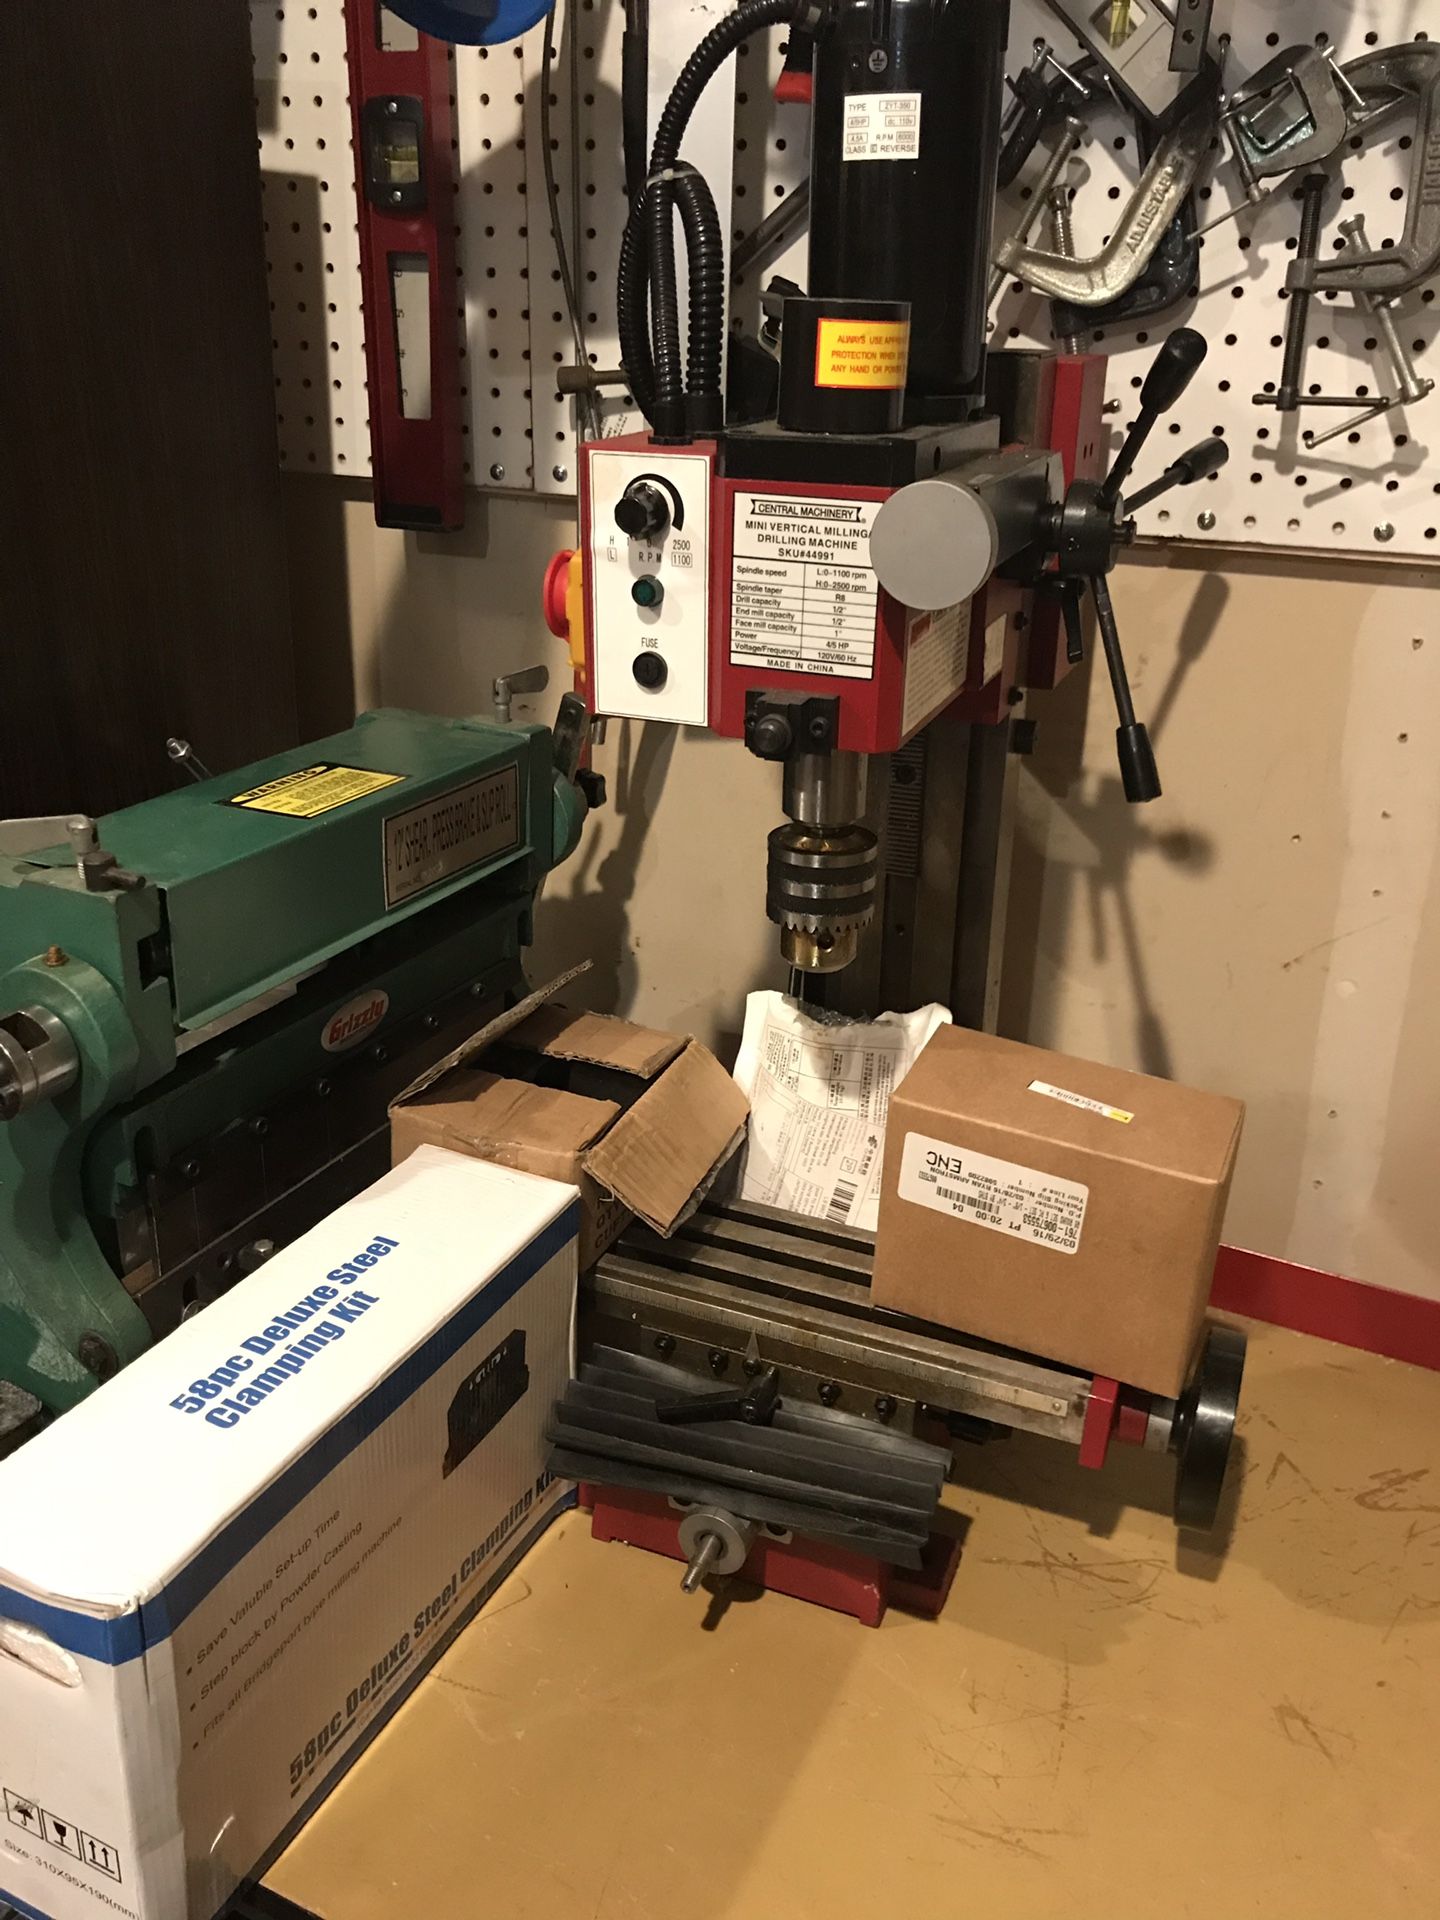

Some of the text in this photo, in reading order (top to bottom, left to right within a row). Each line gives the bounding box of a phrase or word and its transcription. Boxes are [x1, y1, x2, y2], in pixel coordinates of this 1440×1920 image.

[848, 103, 867, 112] TYPE
[845, 145, 867, 155] CLASS
[880, 144, 917, 153] REVERSE
[837, 335, 866, 345] ALWAYS
[831, 350, 877, 360] PROTECTION
[831, 364, 847, 373] ANY
[849, 365, 870, 374] HAND
[758, 503, 854, 519] CENTRAL MACHINERY
[745, 520, 767, 531] MINI
[769, 522, 822, 536] VERTICAL
[672, 539, 691, 551] 2500
[757, 533, 858, 550] DRILLING MACHINE
[609, 550, 615, 560] L
[673, 555, 691, 566] 1100
[778, 547, 835, 561] SKU#44991
[736, 565, 787, 578] Spindle speed
[852, 571, 867, 581] rpm
[735, 583, 783, 595] Spindle taper
[851, 583, 867, 592] rpm
[735, 594, 781, 609] Drill capacity
[735, 606, 795, 621] End mill capacity
[735, 618, 797, 633] Face mill capacity
[735, 630, 757, 640] Power
[641, 637, 659, 649] FUSE
[735, 642, 800, 658] Voltage/Frequency
[838, 641, 849, 649] HP
[817, 651, 857, 663] 120V/60 Hz
[767, 658, 834, 674] MADE IN CHINA
[243, 769, 317, 799] WARNING
[329, 999, 385, 1046] Grizzly
[925, 1151, 962, 1174] ENC
[930, 1167, 969, 1185] ARMSTRON
[971, 1179, 992, 1192] RYAN
[1007, 1183, 1035, 1198] Number
[1048, 1188, 1065, 1198] Line
[1036, 1192, 1052, 1203] Slip
[1053, 1196, 1083, 1212] Packing
[1067, 1193, 1084, 1204] Your
[1035, 1199, 1063, 1214] Number
[952, 1202, 1075, 1249] 03/29/16 PT 20:00 04
[169, 1235, 400, 1414] 58pc Deluxe Steel
[205, 1290, 380, 1429] Clamping Kit
[197, 1510, 341, 1665] Save Valuble Set-up Time
[200, 1521, 363, 1701] Step block by Powder Casting
[203, 1515, 403, 1738] Fits all Bridgeport type milling machine
[289, 1711, 342, 1785] 58pc
[345, 1630, 411, 1719] Deluxe
[413, 1573, 458, 1639] Steel
[460, 1486, 533, 1584] Clamping
